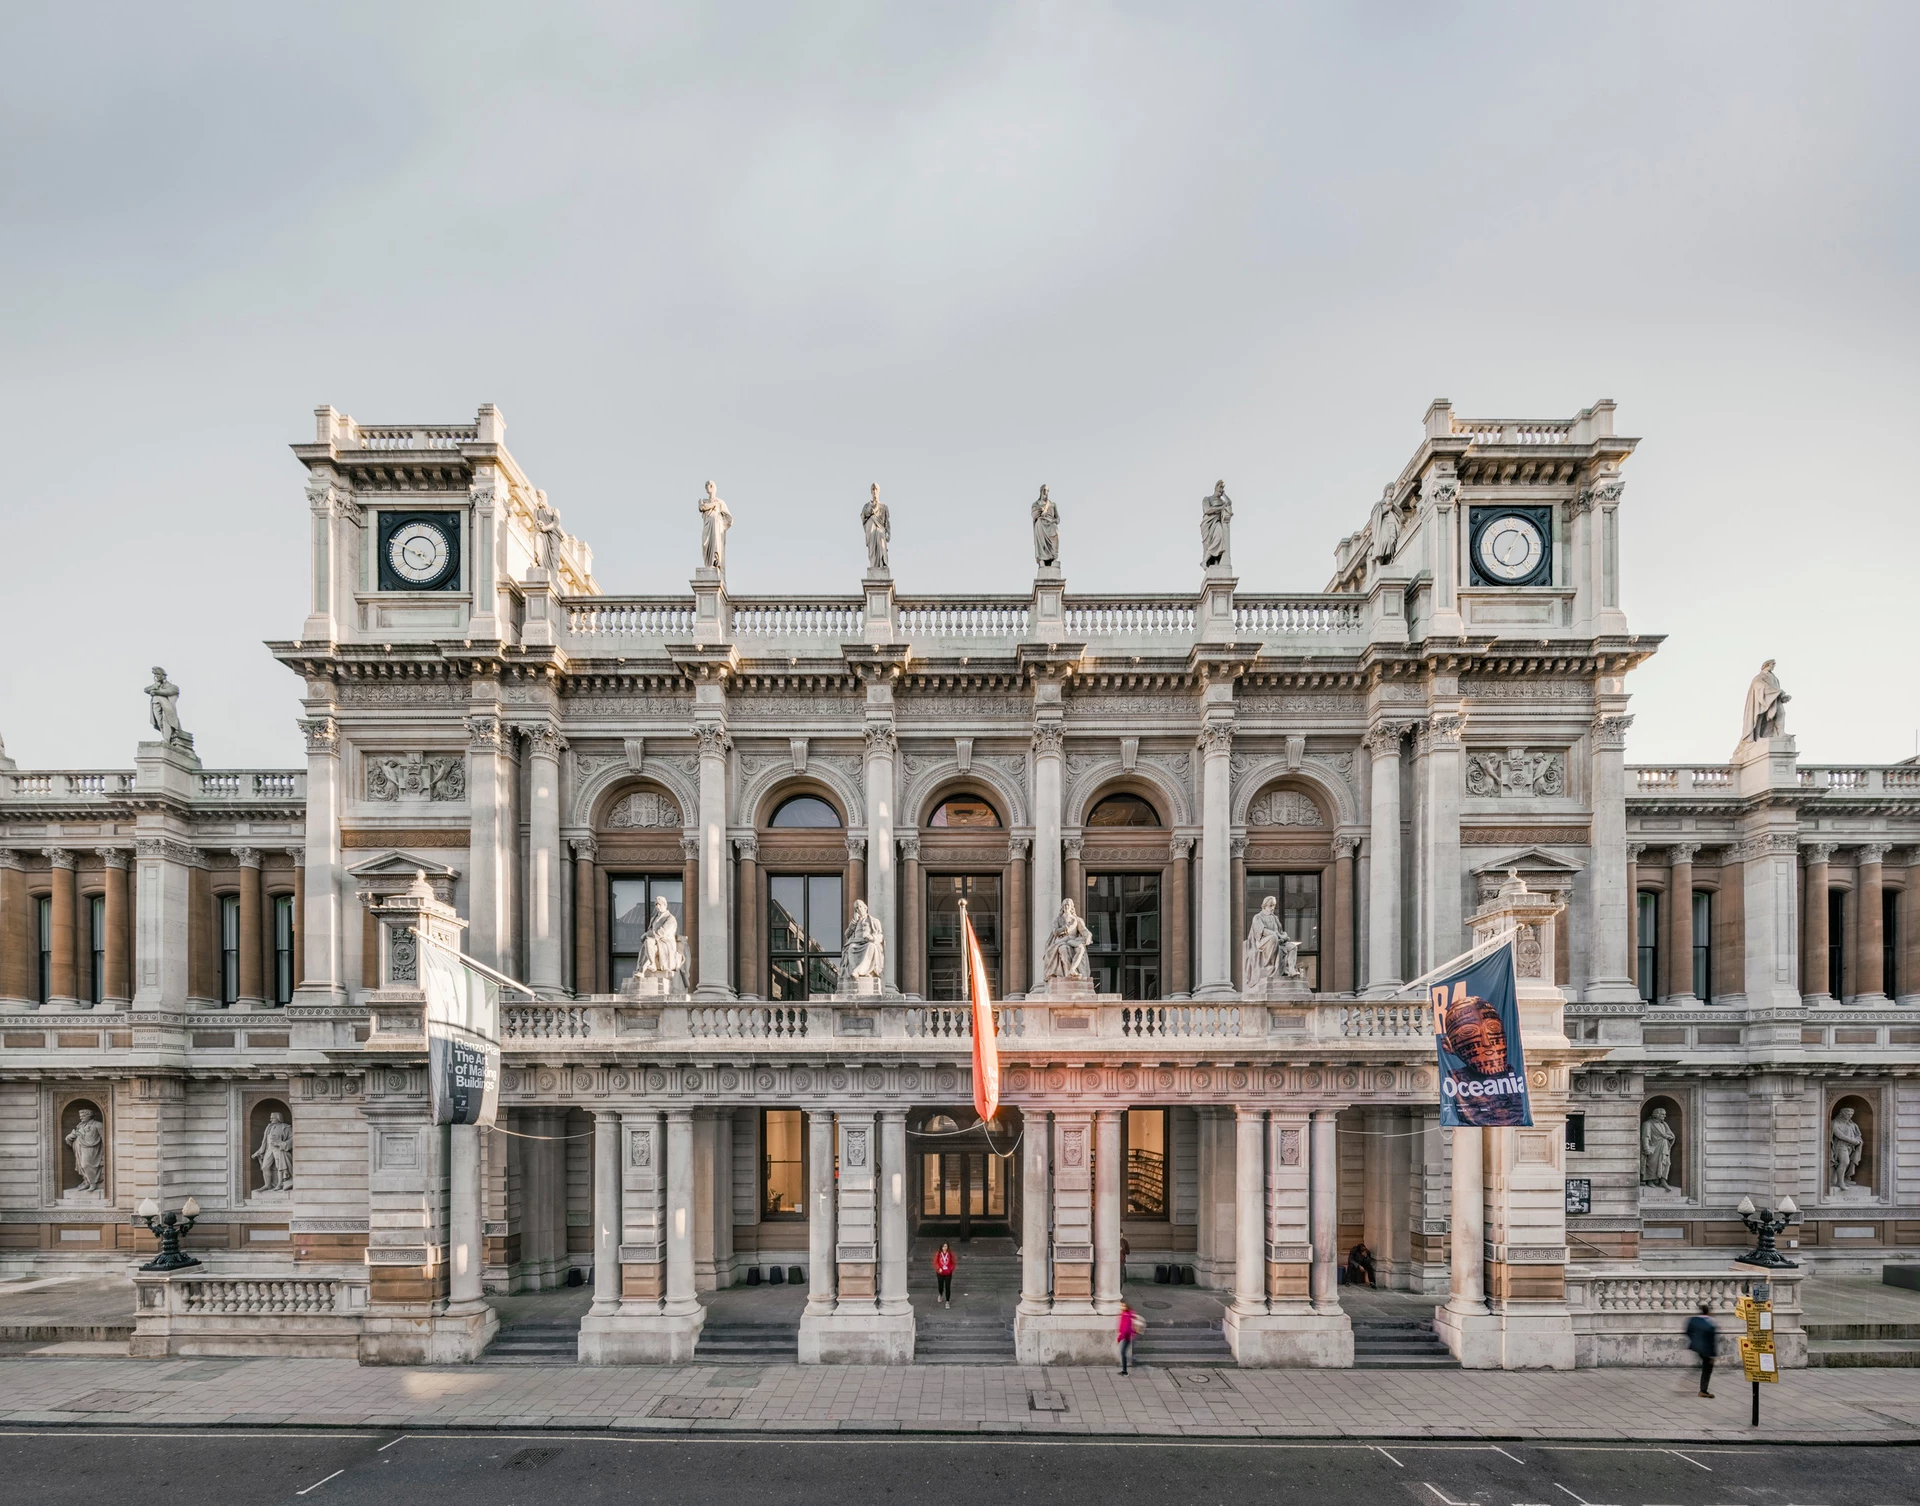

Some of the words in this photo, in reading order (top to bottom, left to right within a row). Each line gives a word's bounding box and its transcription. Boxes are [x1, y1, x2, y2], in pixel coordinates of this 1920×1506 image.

[454, 1037, 484, 1054] Renzo
[454, 1050, 475, 1064] The
[476, 1053, 489, 1066] Art
[455, 1063, 468, 1075] of
[469, 1064, 497, 1081] Making
[456, 1075, 495, 1092] Buildings
[1442, 1072, 1524, 1098] Oceania
